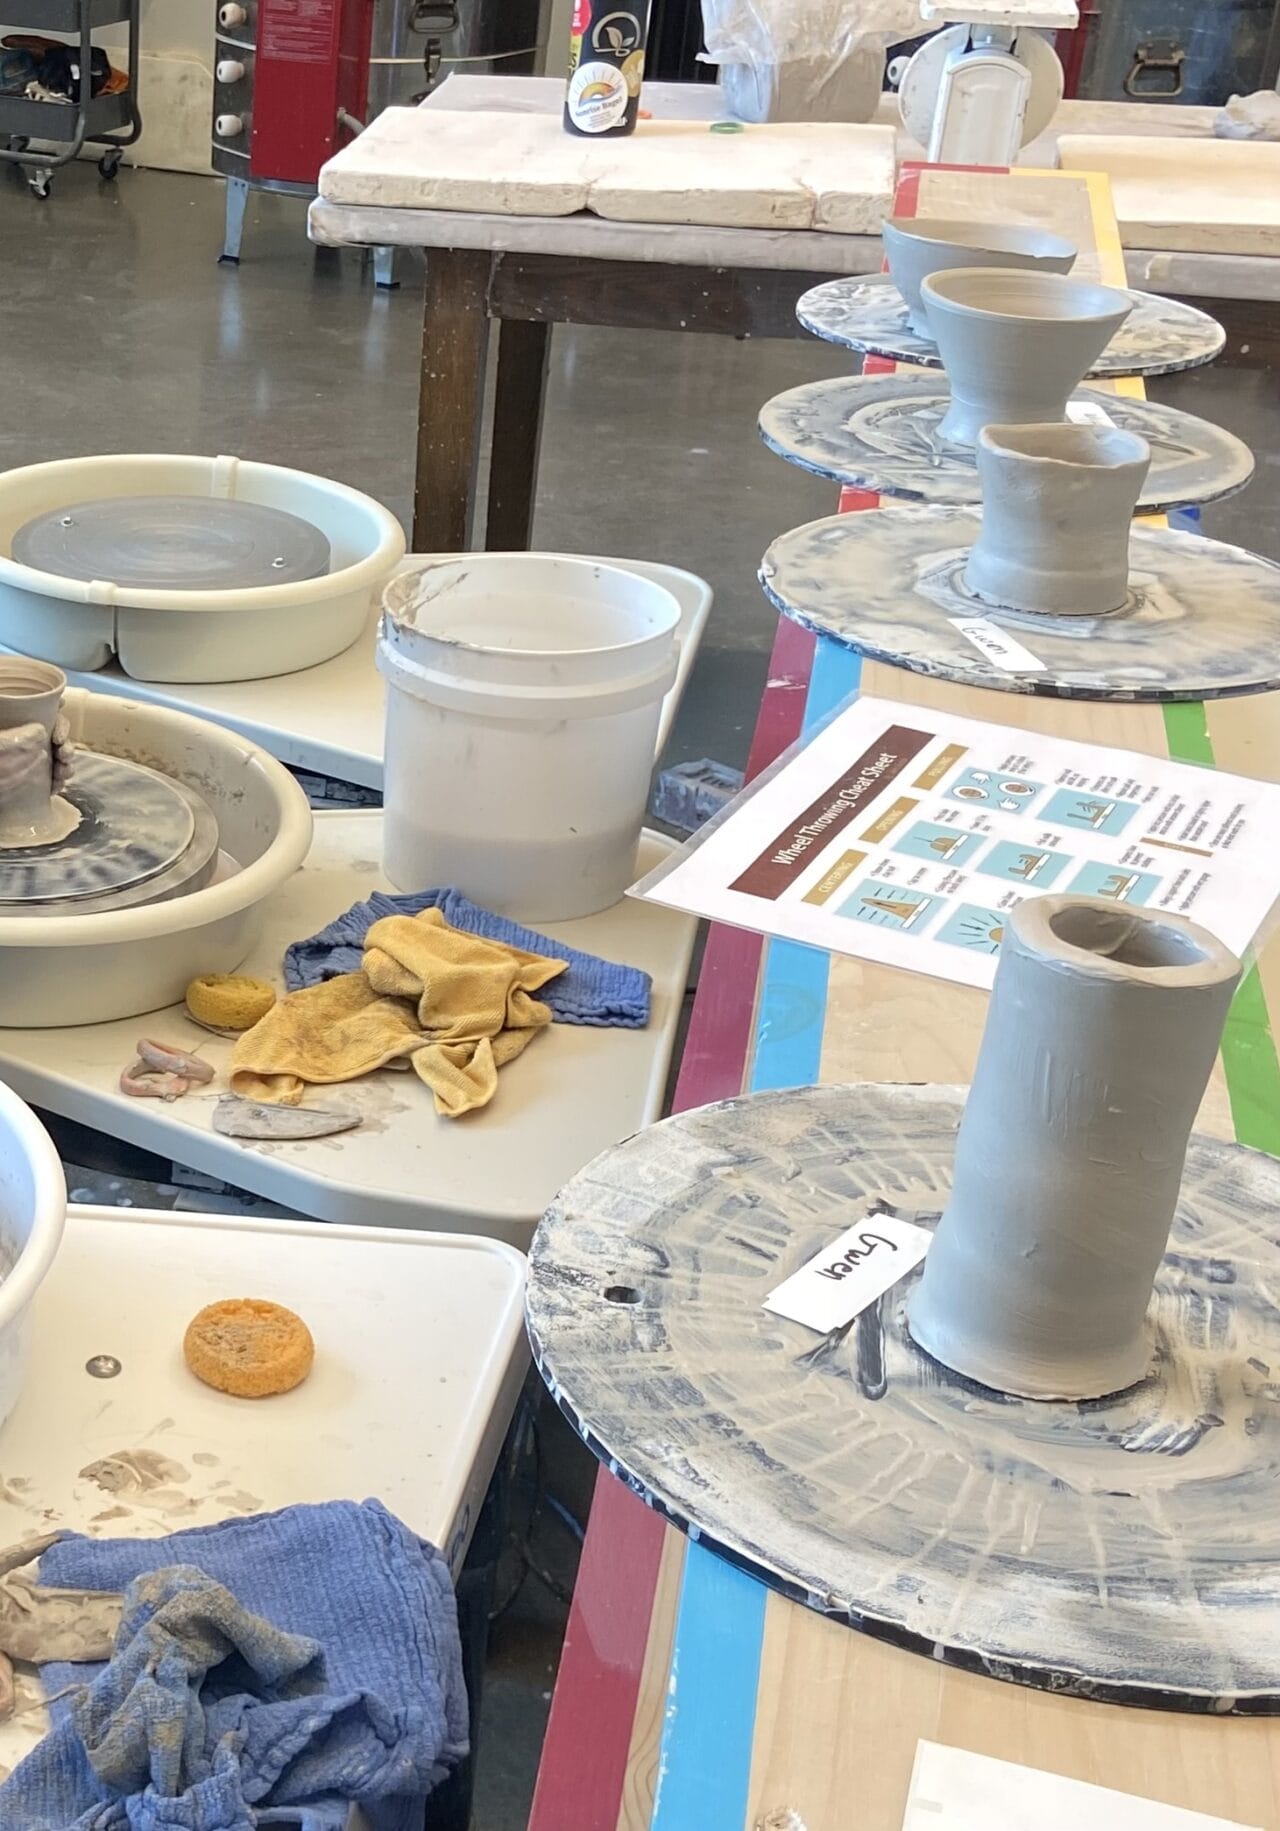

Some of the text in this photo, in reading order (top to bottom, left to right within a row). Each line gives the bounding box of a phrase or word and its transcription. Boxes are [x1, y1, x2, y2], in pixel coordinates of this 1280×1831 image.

[962, 627, 1008, 655] Gwen
[772, 753, 897, 865] Wheel Throwing Cheat Sheet
[819, 862, 853, 893] CENTERING
[815, 1233, 898, 1281] Gwen
